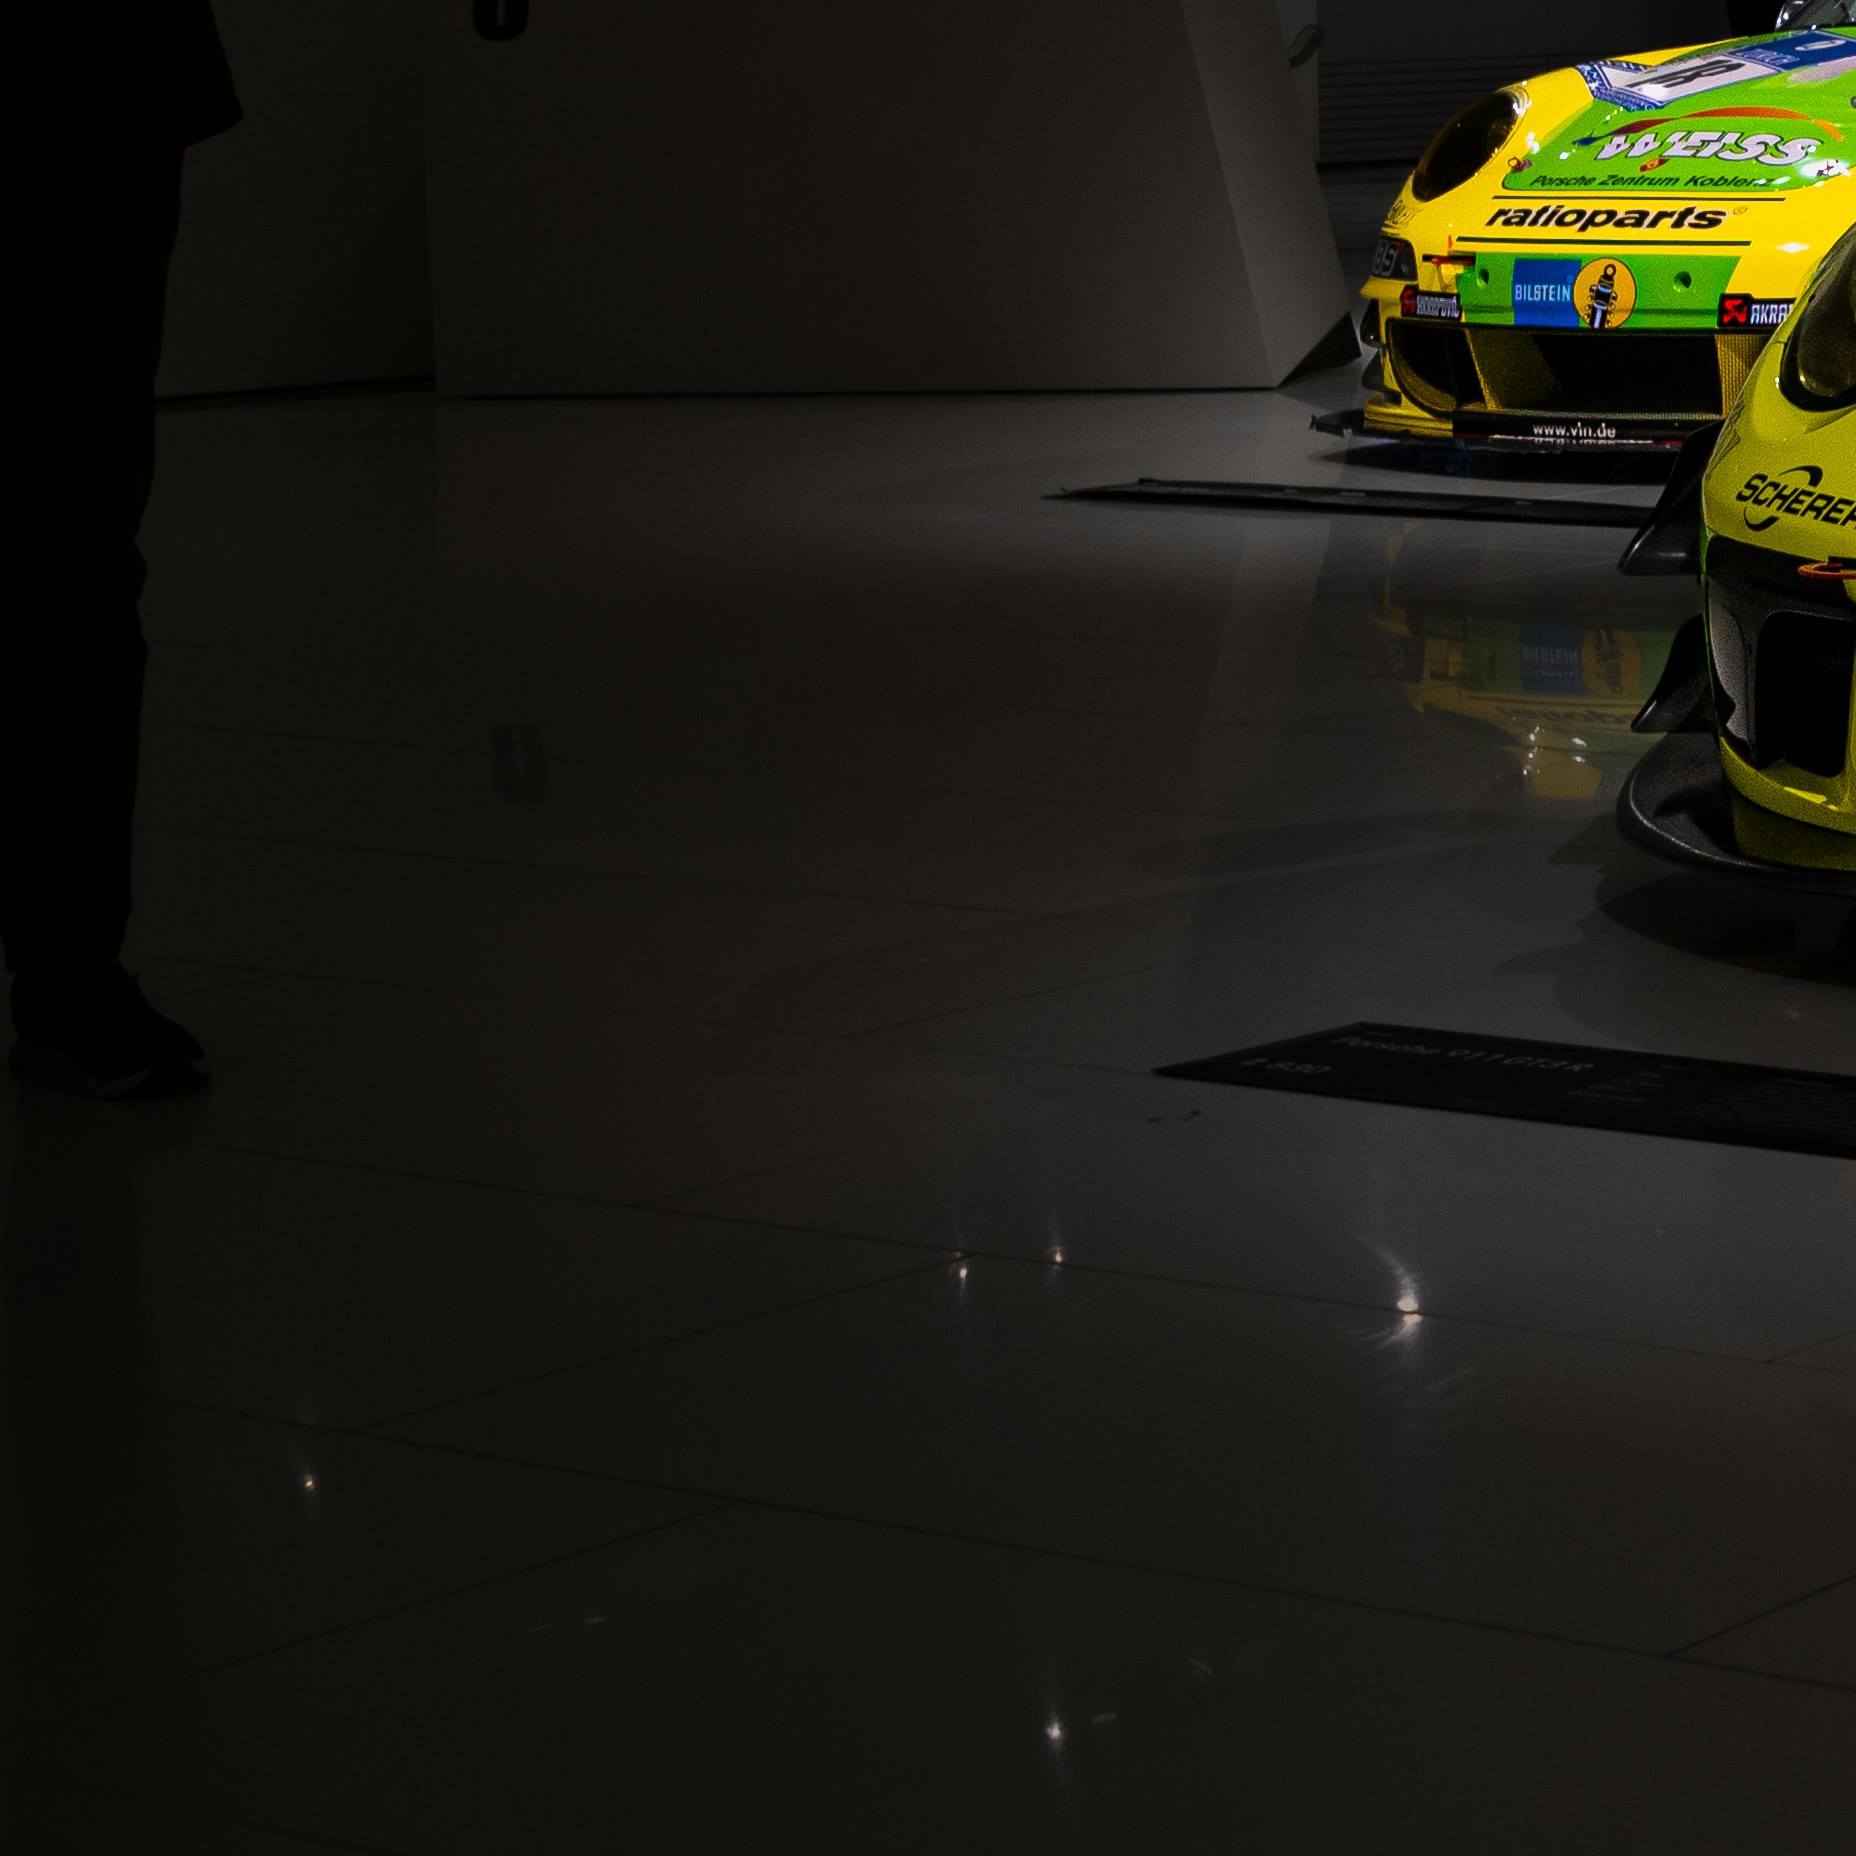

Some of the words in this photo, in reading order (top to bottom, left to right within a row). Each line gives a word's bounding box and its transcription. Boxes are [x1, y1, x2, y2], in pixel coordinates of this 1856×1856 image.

[1595, 131, 1823, 166] WEISS
[1529, 174, 1599, 188] Porsche
[1598, 174, 1681, 188] Zentrum
[1686, 175, 1775, 189] Koblenz
[1486, 204, 1727, 232] ratioparts
[1515, 284, 1571, 302] BILSTEIN
